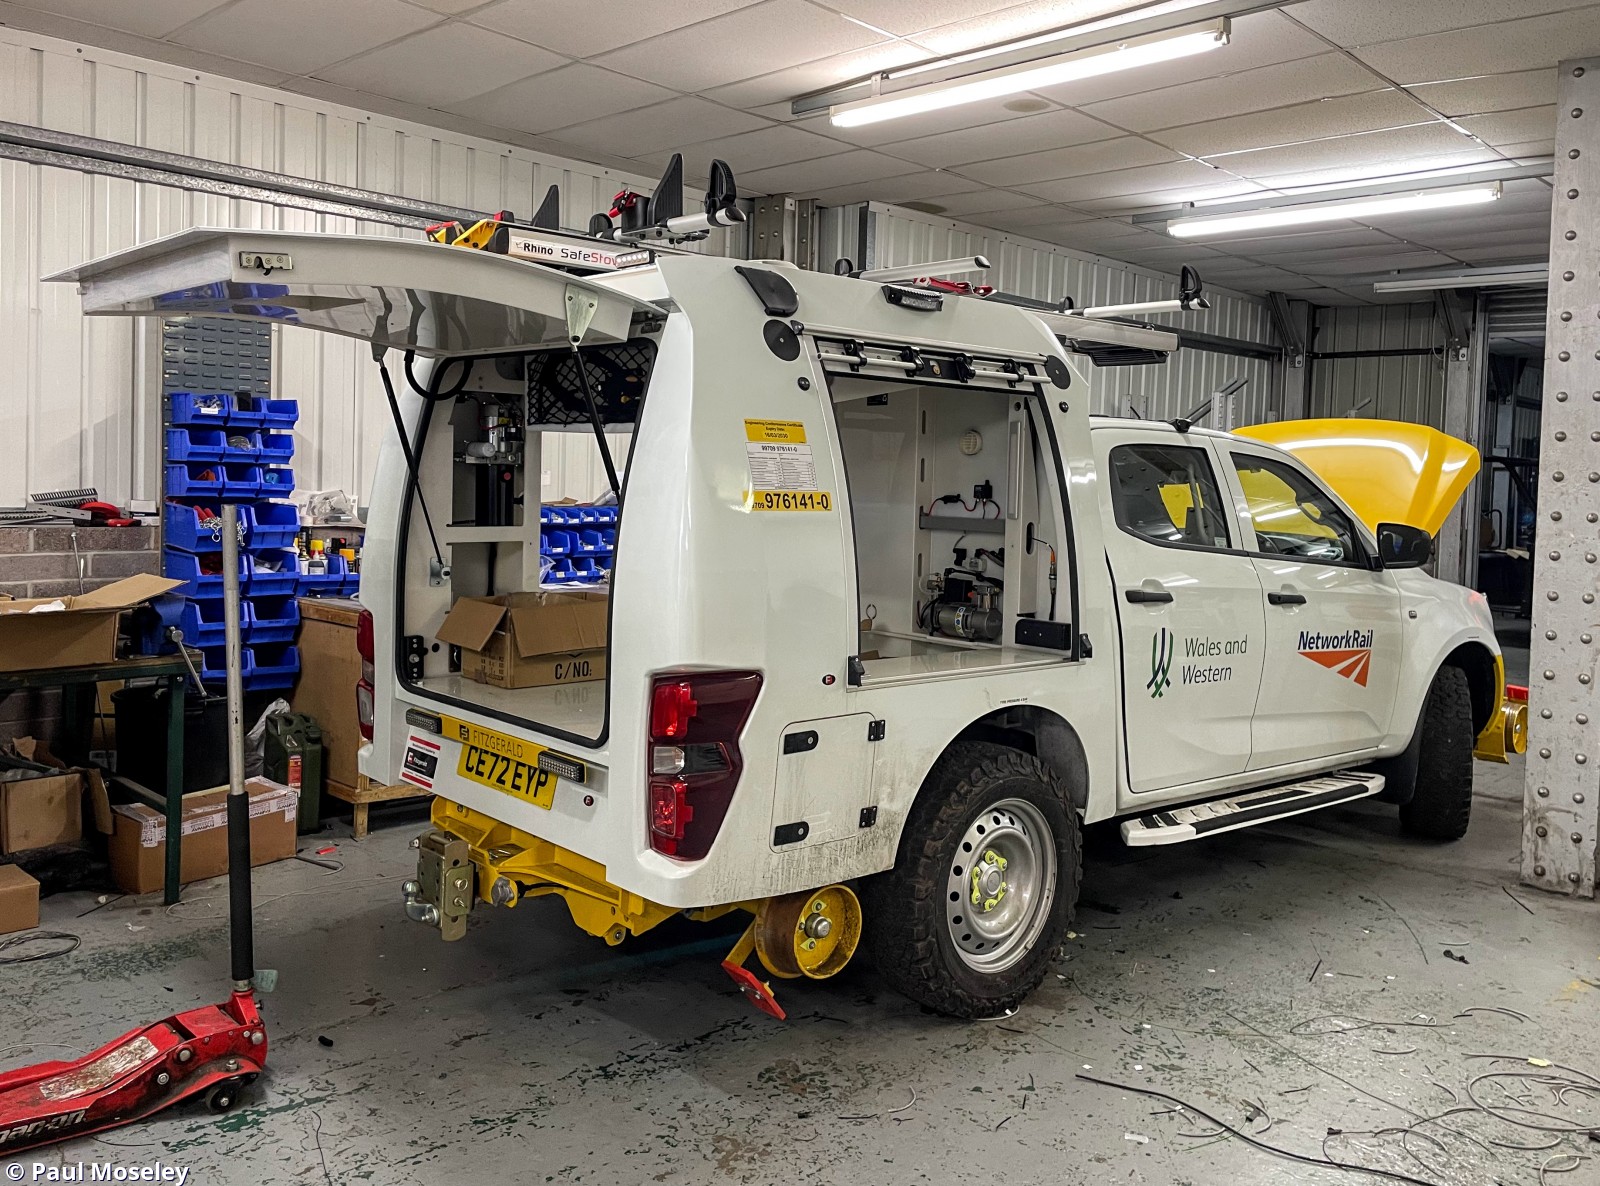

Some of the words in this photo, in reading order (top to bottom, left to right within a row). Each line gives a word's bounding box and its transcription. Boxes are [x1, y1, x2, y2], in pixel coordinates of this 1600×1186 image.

[523, 242, 554, 256] Rhino
[765, 493, 829, 510] 976141-0
[1185, 636, 1221, 657] Wales
[1225, 634, 1248, 655] and
[1298, 629, 1374, 651] NetworkRail
[1182, 665, 1232, 685] Western
[473, 729, 524, 759] FITZGERALD
[465, 744, 511, 786] CE72
[510, 762, 549, 798] EYP
